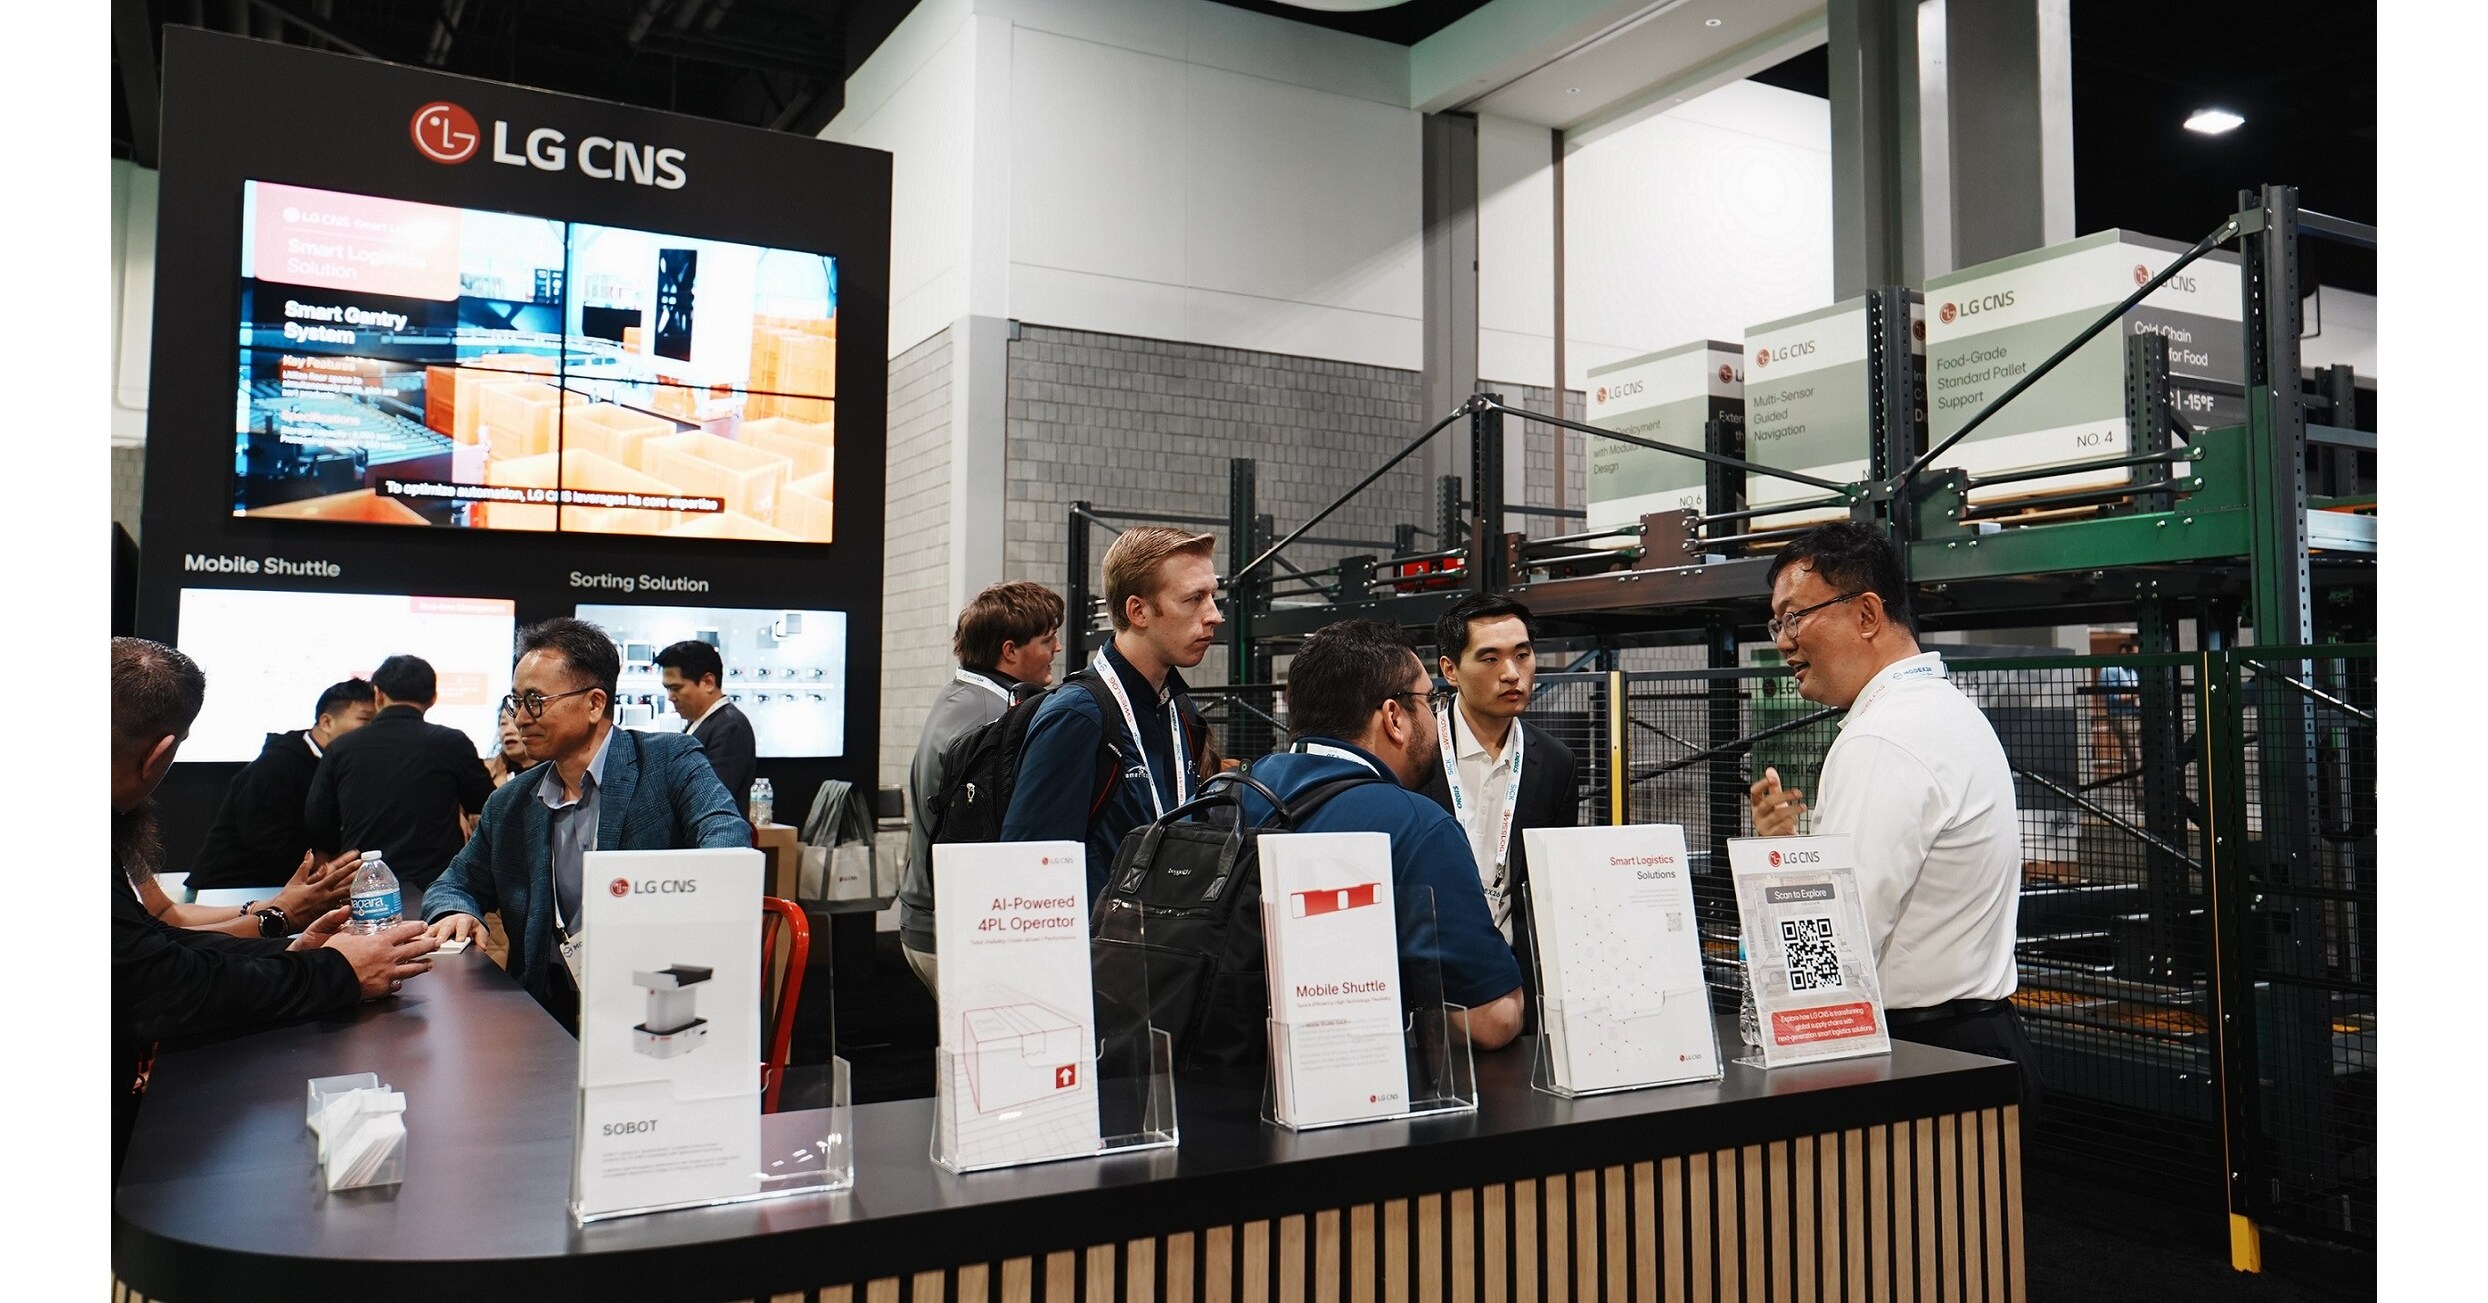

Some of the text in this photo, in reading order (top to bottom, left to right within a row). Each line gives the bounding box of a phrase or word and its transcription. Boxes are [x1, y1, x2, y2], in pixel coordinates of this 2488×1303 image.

[493, 120, 566, 171] LG
[577, 136, 687, 190] CNS
[287, 238, 344, 259] Smart
[286, 256, 357, 279] Solution
[2170, 274, 2197, 293] CNS
[1960, 299, 1980, 318] LG
[1983, 290, 2015, 311] CNS
[284, 300, 408, 331] Smart Gantry
[283, 321, 356, 344] System
[1772, 340, 1816, 362] LG CNS
[1936, 347, 2007, 371] Food-Grade
[2184, 349, 2209, 366] Food
[1937, 361, 2027, 390] Standard Pallet
[1609, 380, 1644, 400] LG CNS
[1753, 386, 1815, 407] Multi-Sensor
[1938, 390, 1984, 410] Support
[1753, 409, 1789, 425] Guided
[1753, 422, 1806, 442] Navigation
[2077, 431, 2113, 448] NO. 4
[1594, 462, 1620, 475] Design
[385, 480, 402, 494] To
[403, 482, 456, 497] optimize
[573, 491, 627, 507] leverages
[627, 493, 642, 506] its
[642, 496, 668, 507] core
[668, 497, 719, 511] expertise
[1696, 497, 1702, 505] 6
[184, 553, 341, 578] Mobile Shuttle
[569, 571, 709, 593] Sorting Solution
[1445, 758, 1454, 776] SICK
[1452, 785, 1462, 810] ORBIS
[1508, 783, 1517, 801] SICK
[1500, 808, 1511, 853] SWISSLOG
[1610, 854, 1674, 867] Smart Logistics
[1783, 852, 1797, 864] LG
[1798, 851, 1820, 864] CNS
[1637, 869, 1676, 880] Solutions
[634, 879, 697, 894] LG CNS
[1774, 888, 1827, 900] Scan to Explore
[991, 895, 1076, 911] AI-Powered
[978, 916, 1076, 932] 4PL Operator
[1296, 980, 1386, 998] Mobile Shuttle
[1818, 1011, 1829, 1019] CNS
[603, 1119, 658, 1137] SOBOT
